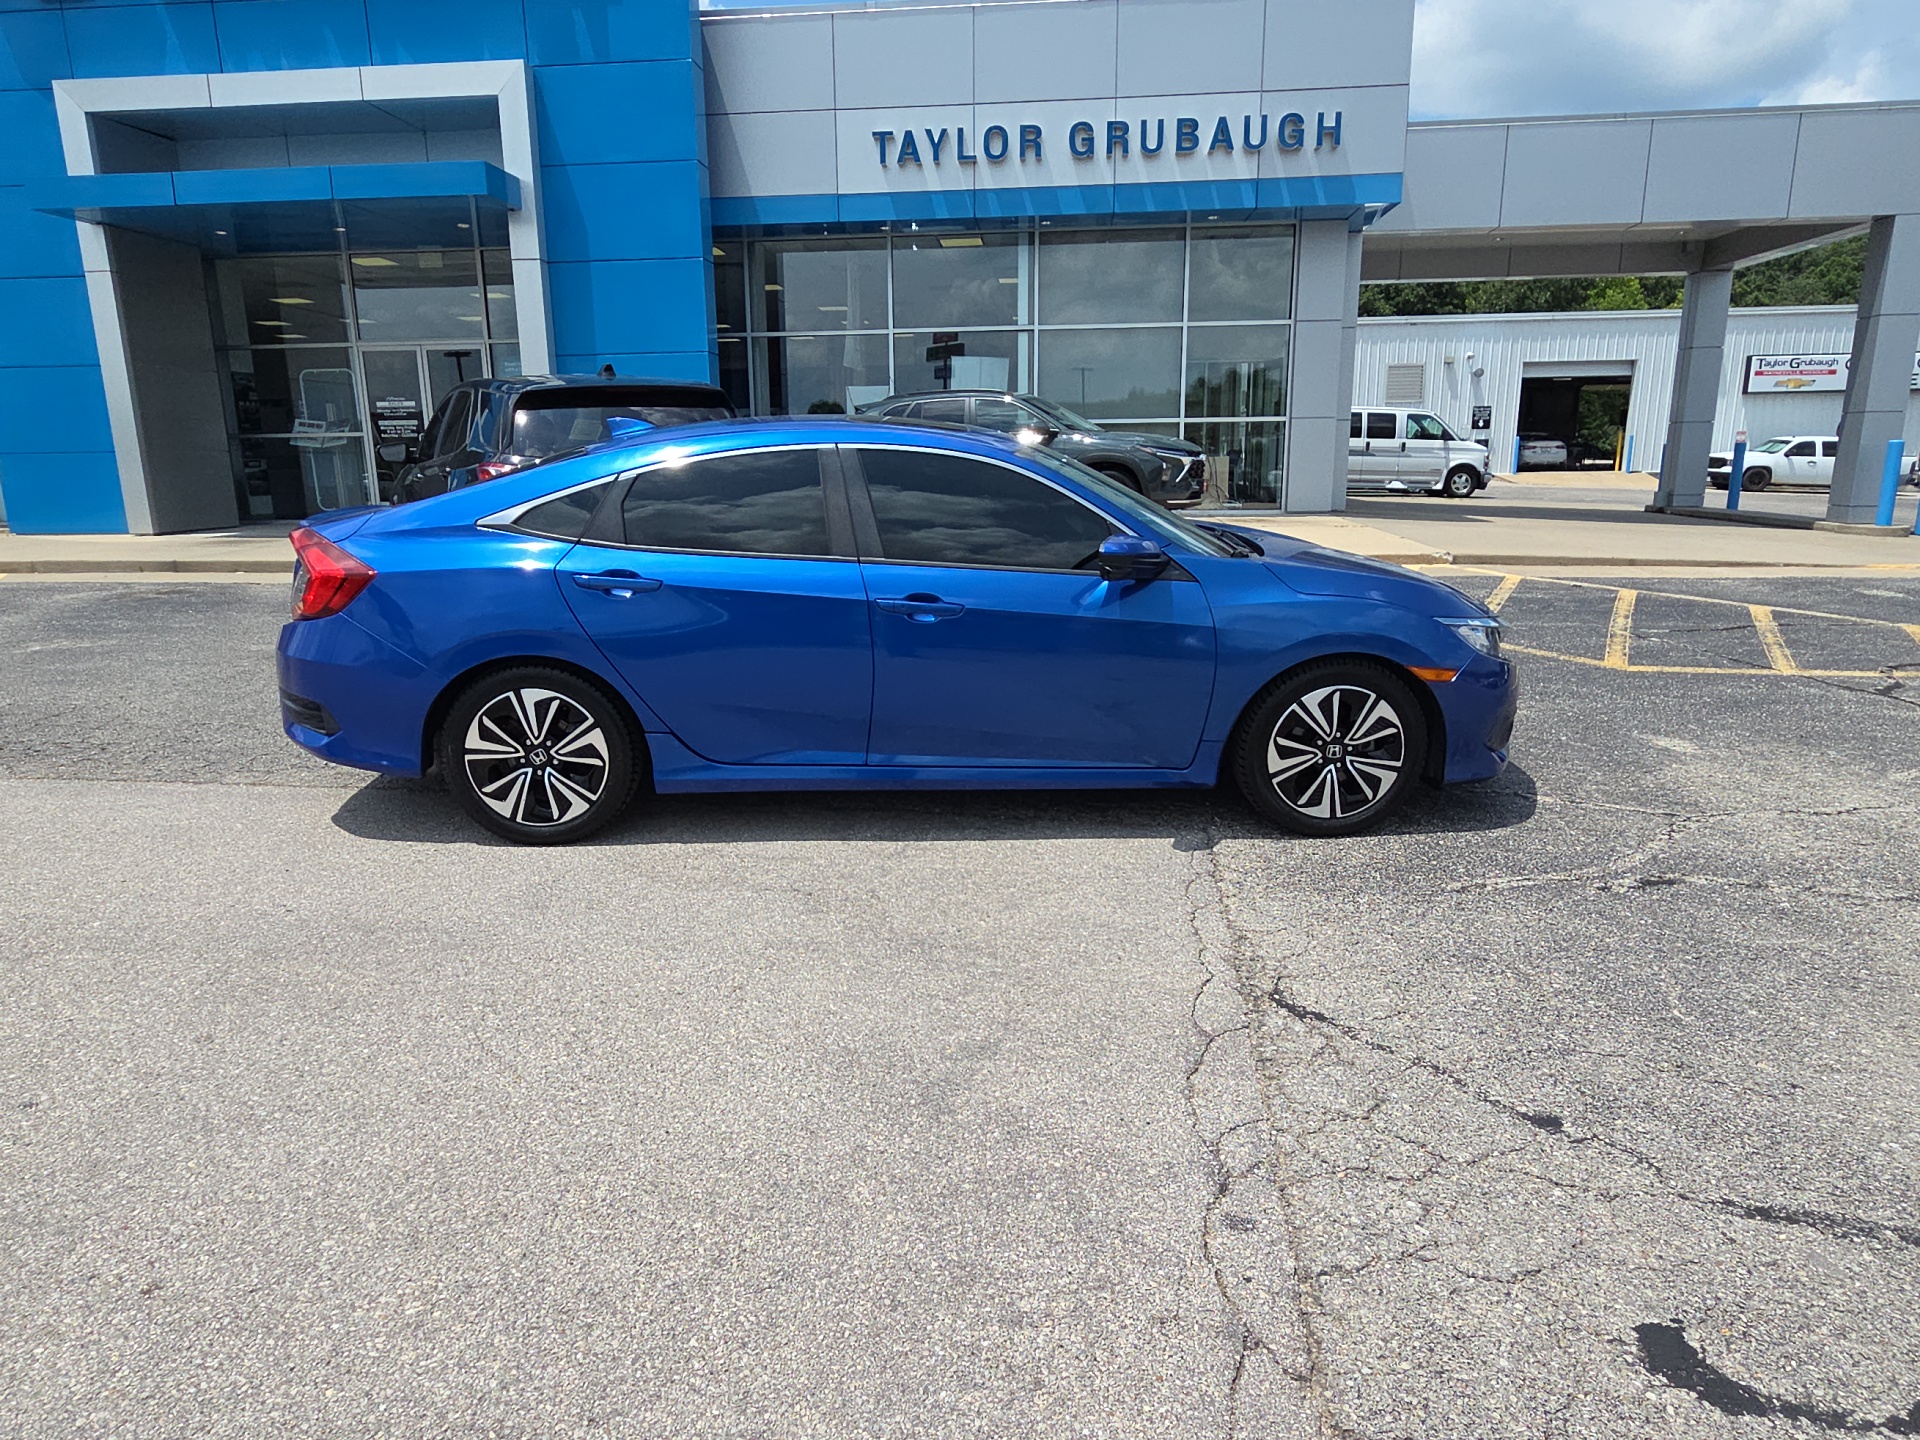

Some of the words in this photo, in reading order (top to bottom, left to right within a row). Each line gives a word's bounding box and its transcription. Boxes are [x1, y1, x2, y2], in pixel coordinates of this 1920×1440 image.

[872, 124, 1043, 166] TAYLOR
[1068, 111, 1343, 159] GRUBAUGH
[1756, 358, 1788, 369] Taylor
[1789, 357, 1839, 369] Grubaugh
